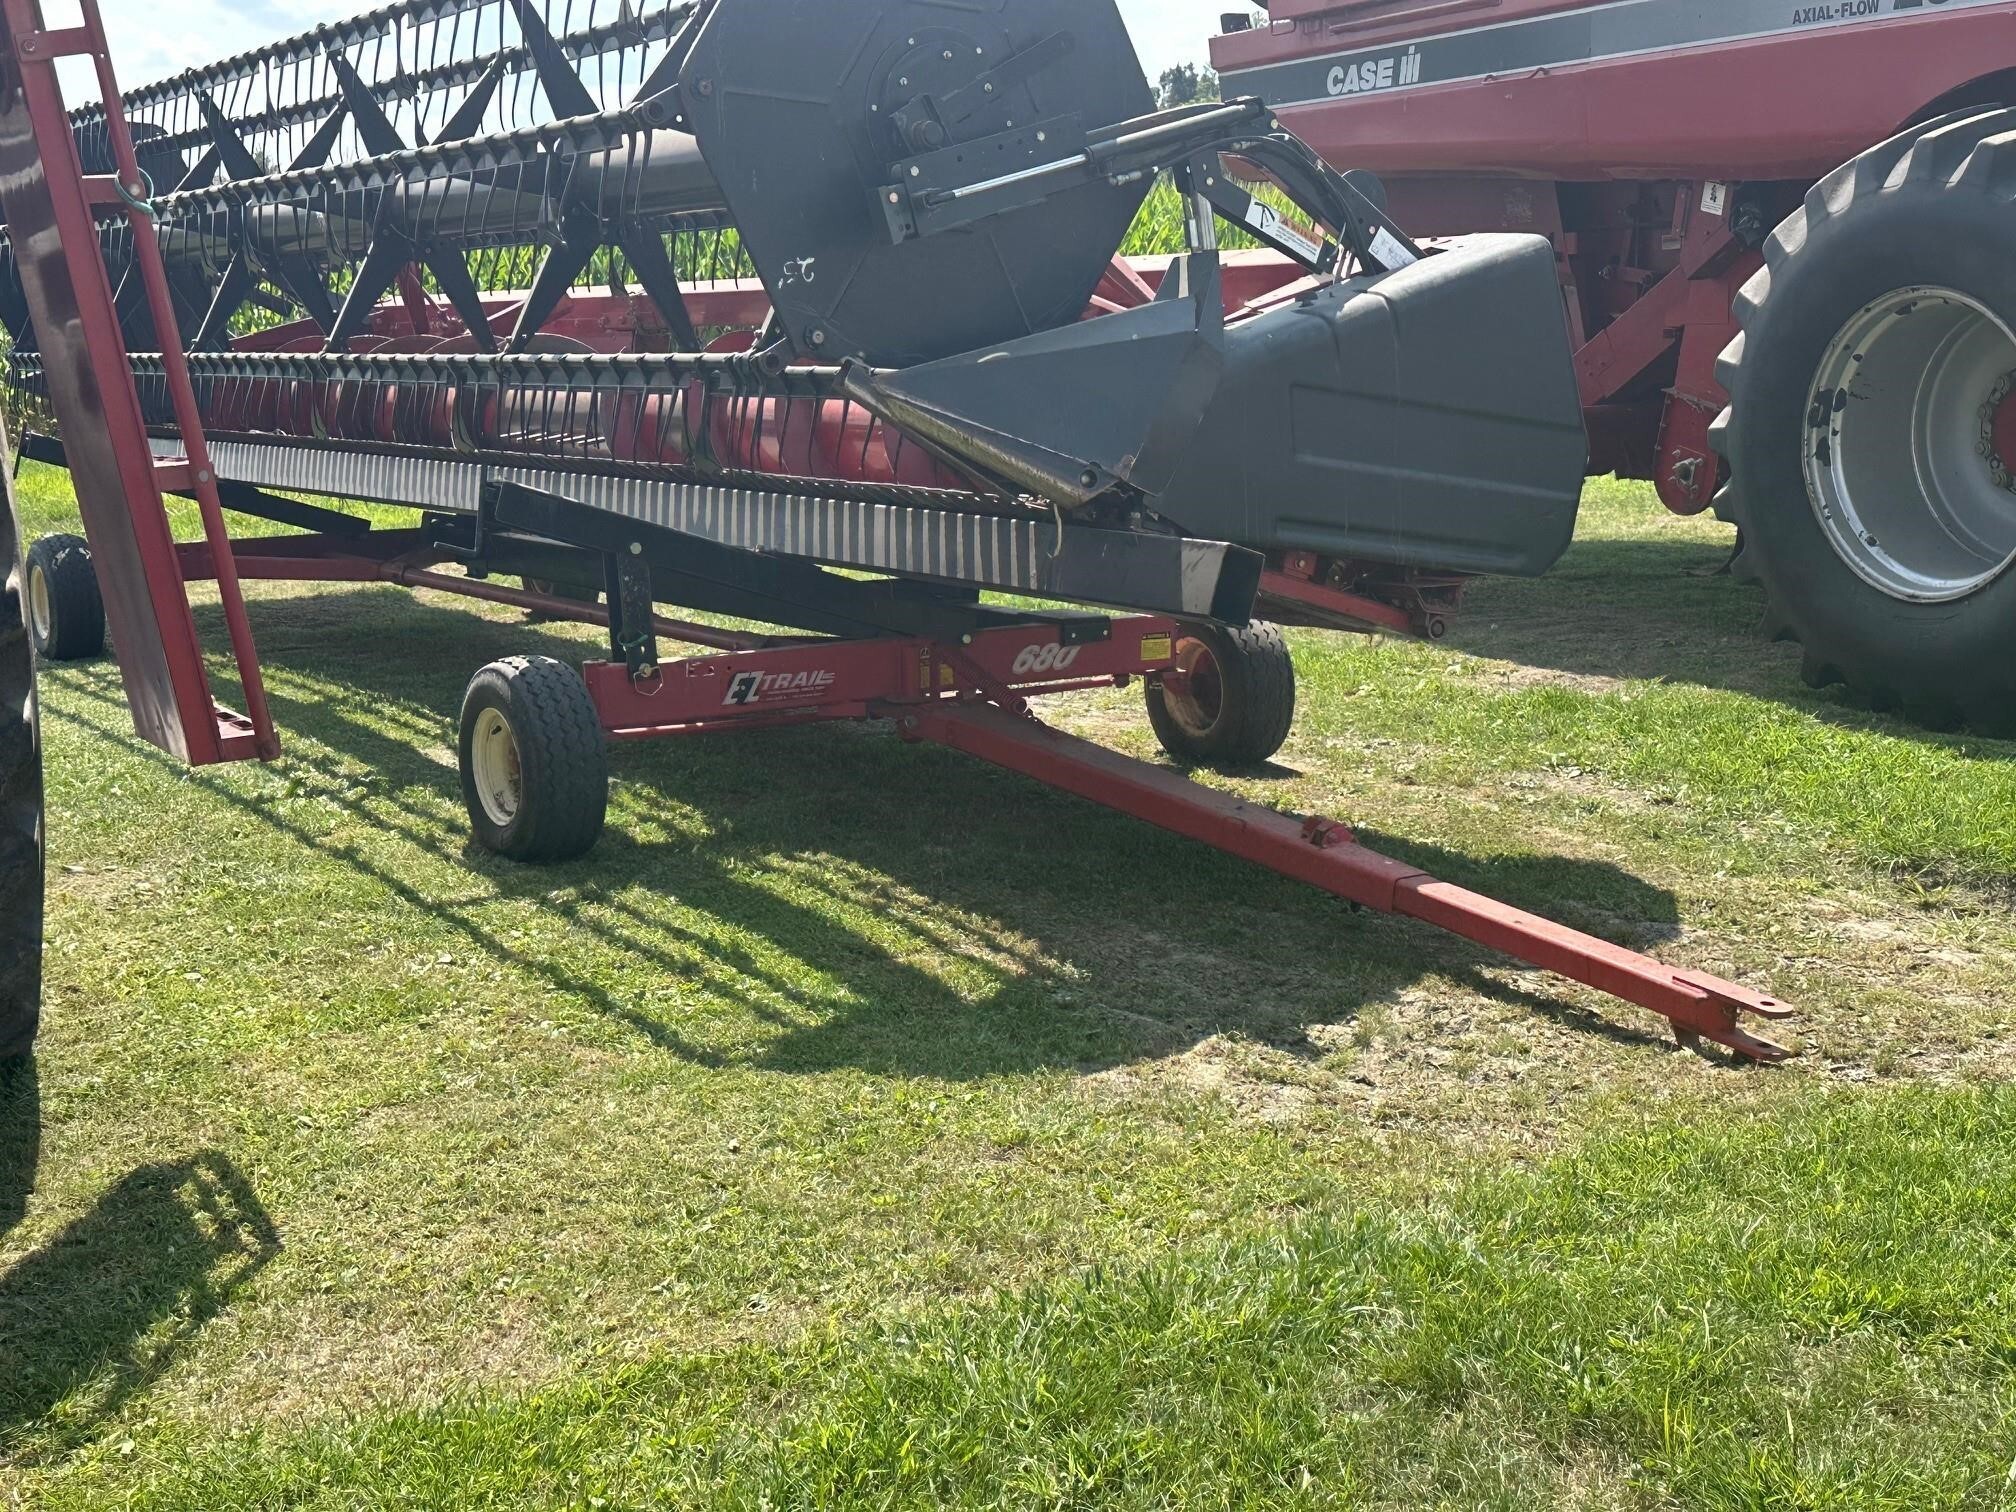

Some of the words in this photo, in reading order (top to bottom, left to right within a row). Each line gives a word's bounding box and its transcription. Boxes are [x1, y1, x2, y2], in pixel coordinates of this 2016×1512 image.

[1792, 0, 1880, 25] AXIAL-FLOW
[1326, 58, 1394, 96] CASE
[1012, 642, 1082, 675] 680
